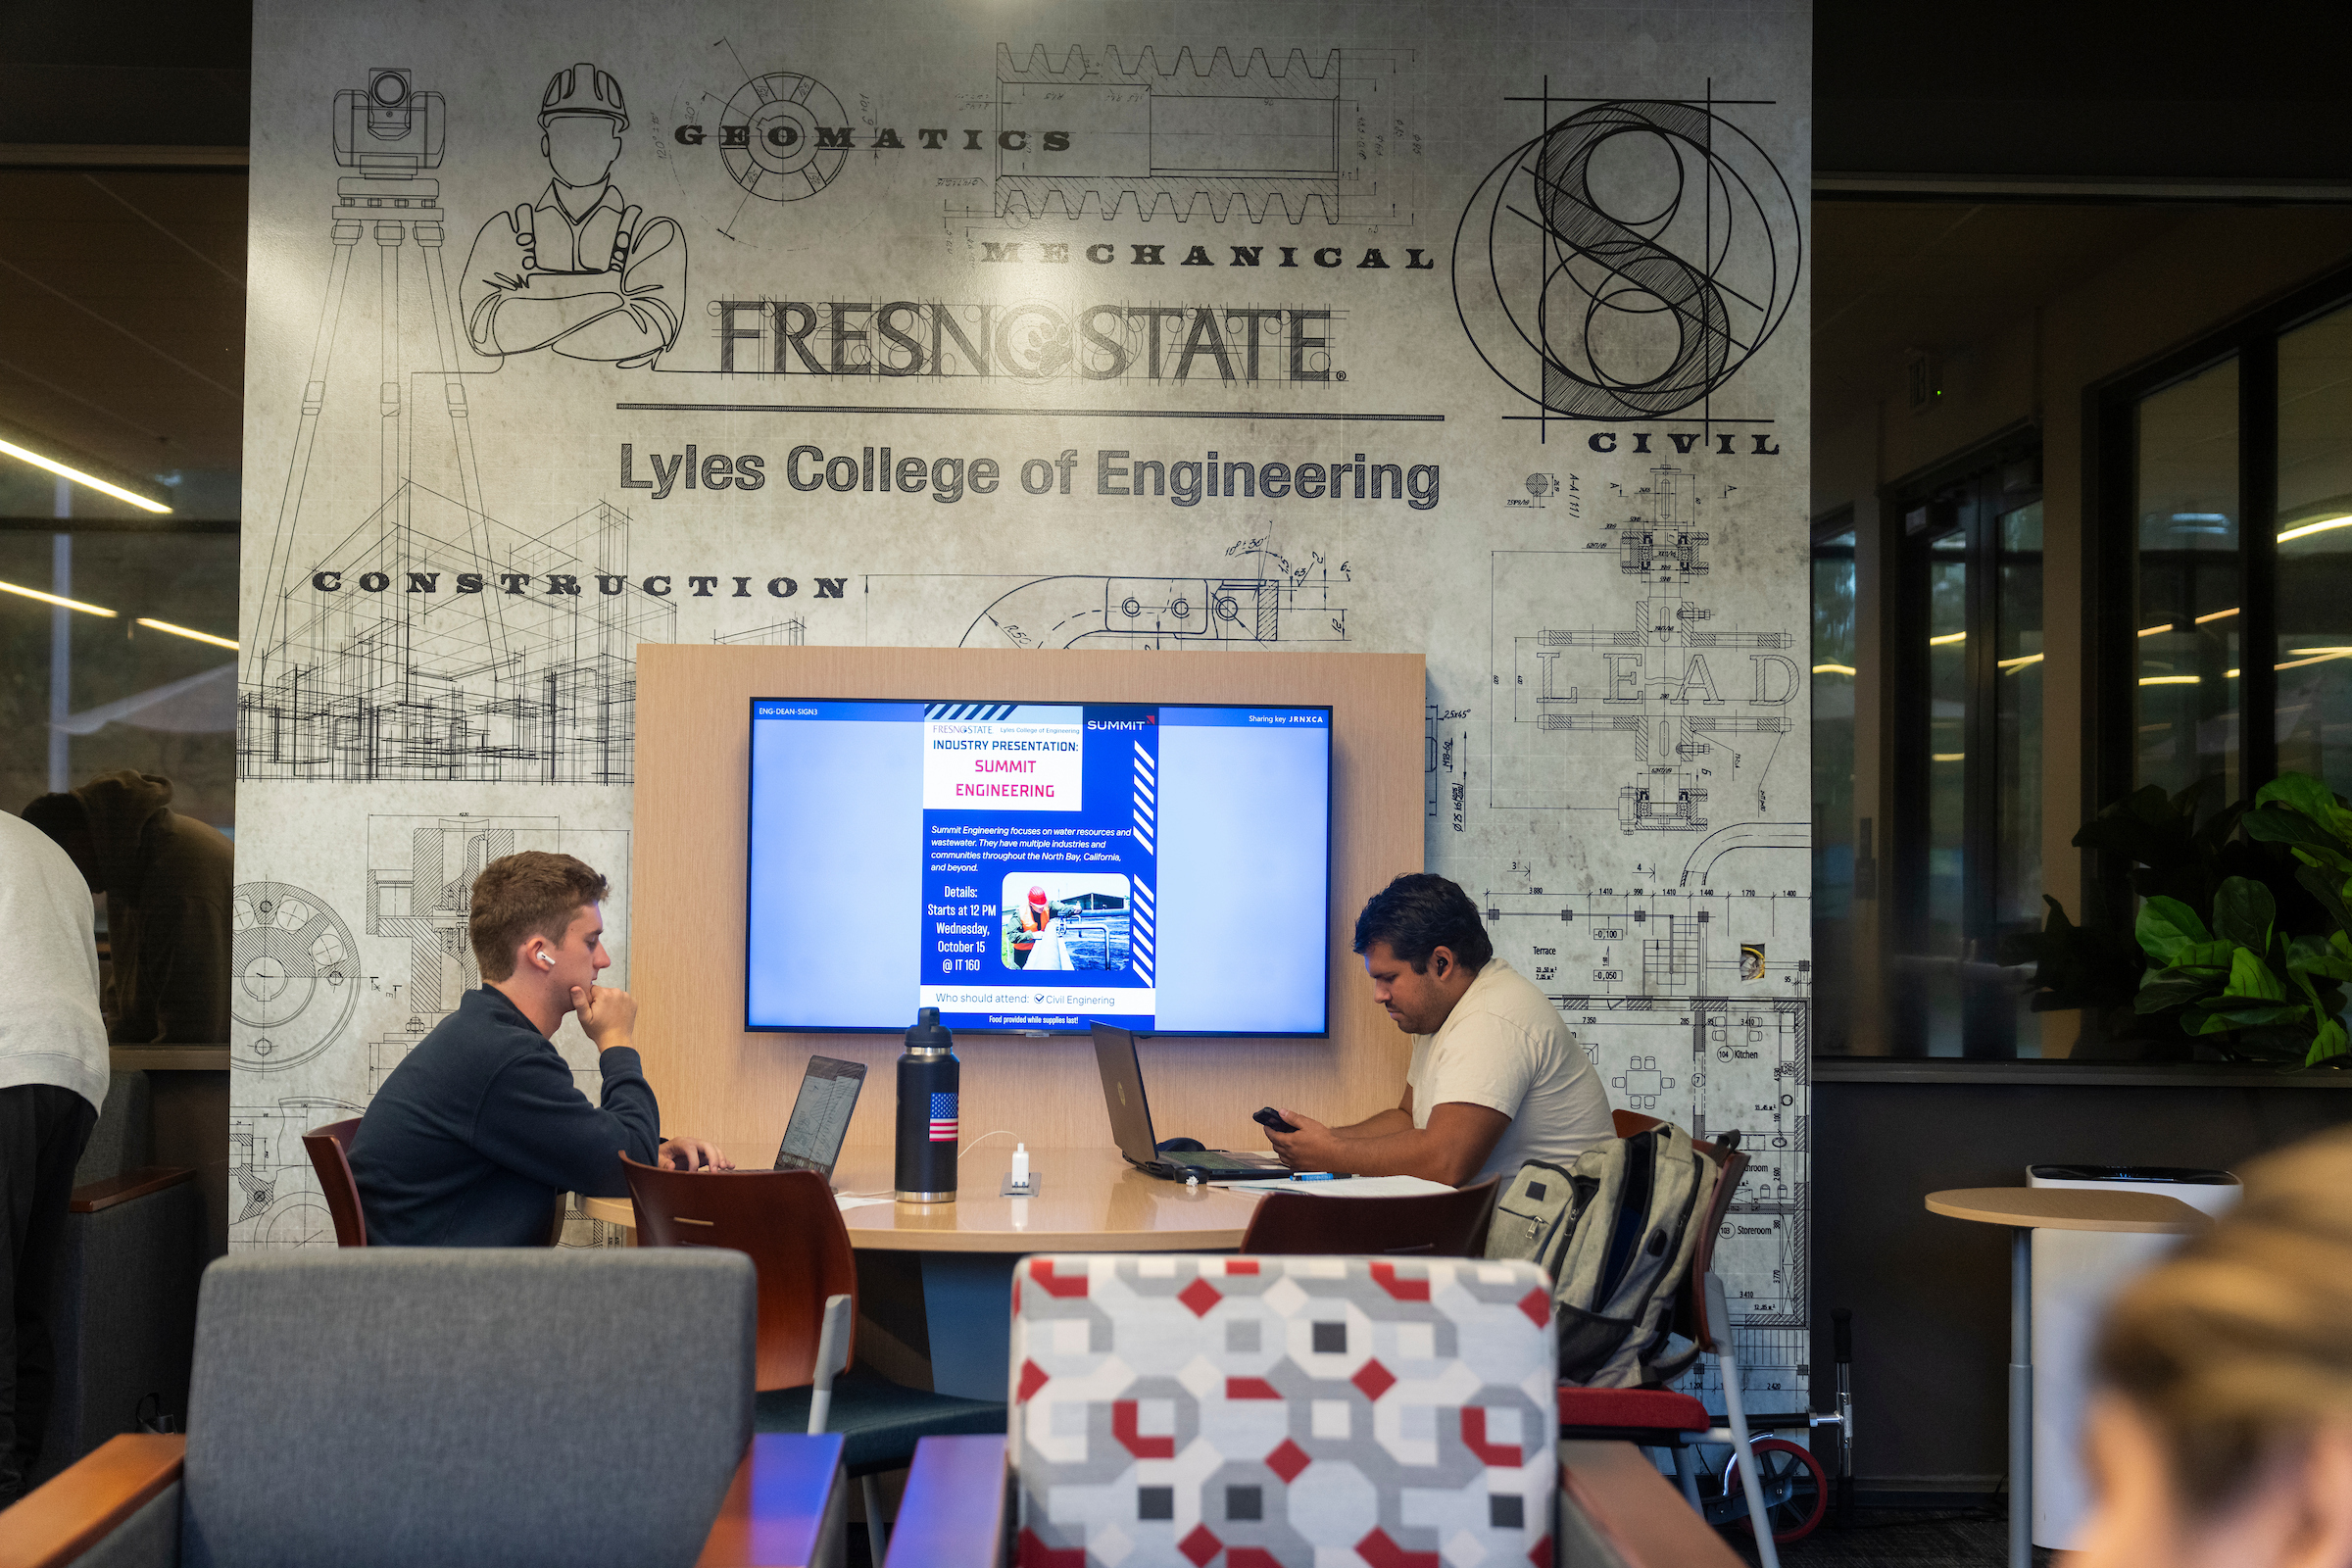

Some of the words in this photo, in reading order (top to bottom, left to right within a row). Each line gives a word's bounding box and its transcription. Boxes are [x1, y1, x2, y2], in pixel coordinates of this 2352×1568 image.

[674, 123, 1070, 152] GEOMATICS
[981, 242, 1434, 270] MECHANICAL
[1588, 432, 1780, 455] CIVIL
[619, 442, 765, 502] Lyles
[786, 444, 1003, 504] College
[1021, 447, 1079, 496] of
[1098, 450, 1442, 509] Engineering
[312, 570, 849, 599] CONSTRUCTION
[1537, 653, 1799, 706] LEAD
[1087, 720, 1145, 730] SUMMIT
[933, 740, 989, 750] INDUSTRY
[992, 741, 1079, 752] PRESENTATION:
[975, 760, 1036, 773] SUMMIT
[956, 783, 1054, 798] ENGINEERING
[962, 826, 1008, 836] Engineering
[1010, 826, 1041, 835] focuses
[979, 839, 999, 849] They
[1019, 840, 1051, 849] multiple
[1052, 840, 1090, 849] industries
[983, 852, 1026, 861] throughout
[1066, 853, 1082, 861] Bay,
[1083, 853, 1121, 861] California,
[945, 886, 977, 898] Details:
[928, 904, 956, 915] Starts
[958, 905, 967, 916] at
[970, 905, 979, 915] 12
[982, 905, 996, 916] PM
[936, 922, 990, 937] Wednesday,
[938, 941, 974, 953] October
[976, 941, 985, 953] 15
[1533, 946, 1556, 956] Terrace
[943, 958, 953, 973] @
[956, 959, 962, 970] IT
[965, 959, 980, 970] 160
[936, 994, 958, 1003] Who
[960, 994, 992, 1003] should
[995, 994, 1029, 1004] attend:
[1046, 995, 1064, 1004] Civil
[1067, 996, 1115, 1006] Enginering
[1004, 1015, 1026, 1024] provided
[1043, 1016, 1065, 1025] supplies
[1735, 1051, 1758, 1059] Kitchen
[1738, 1225, 1772, 1235] Storeroom
